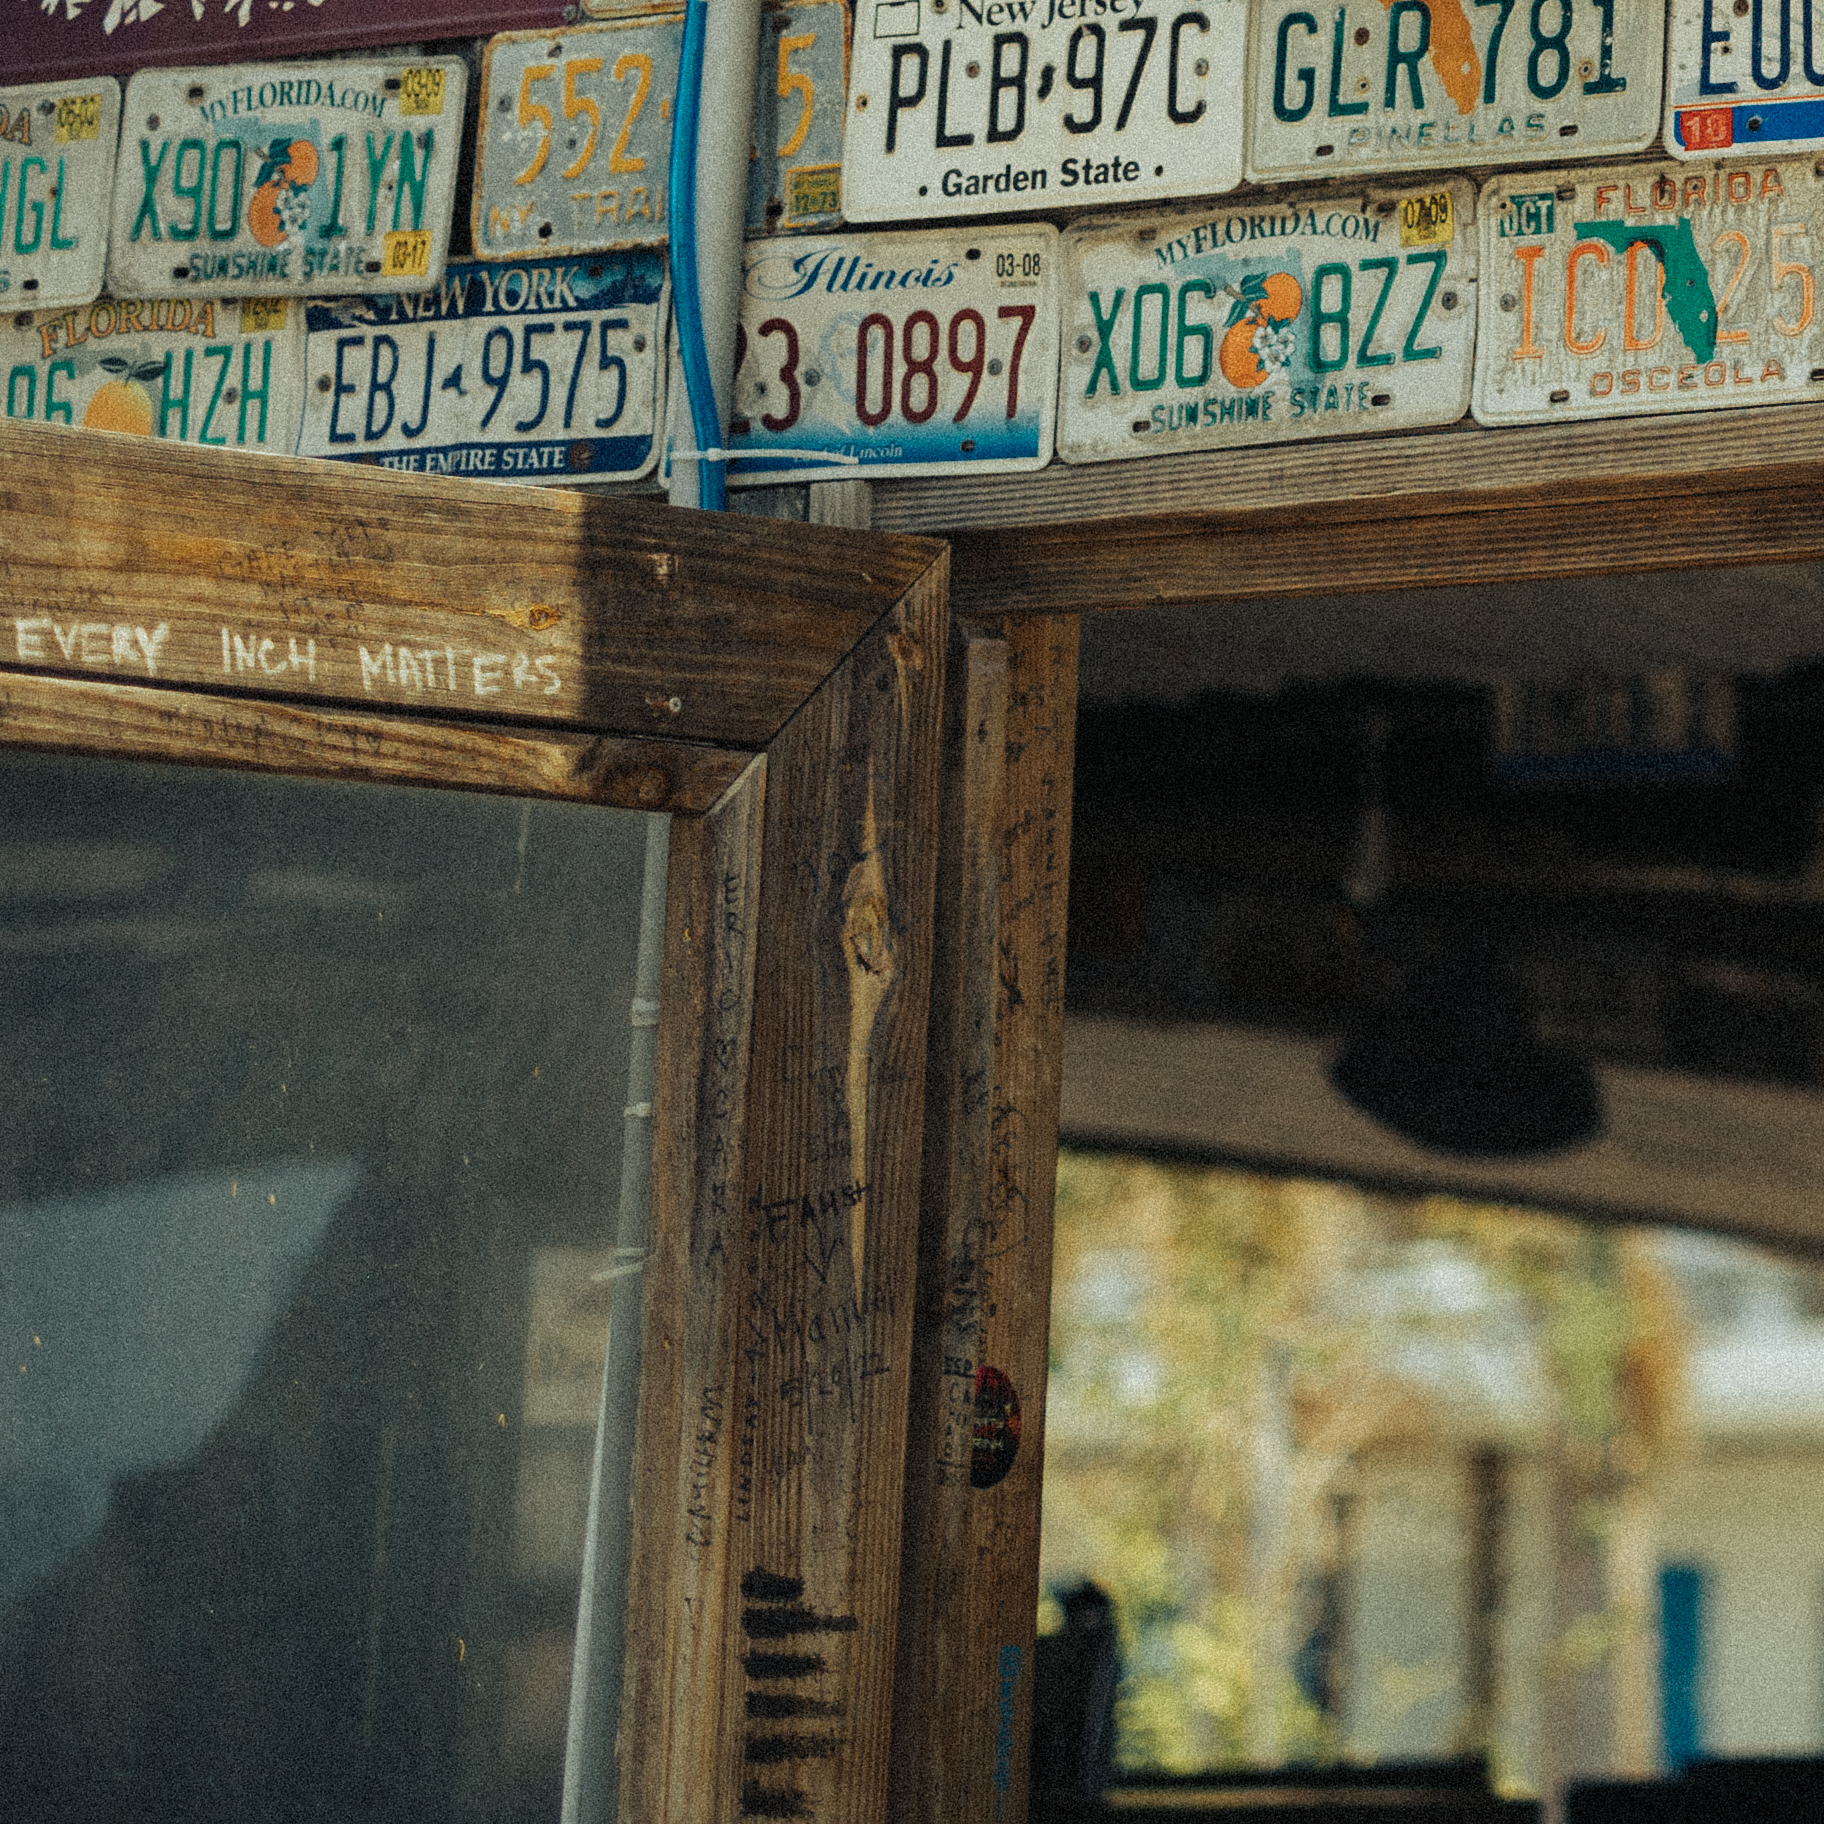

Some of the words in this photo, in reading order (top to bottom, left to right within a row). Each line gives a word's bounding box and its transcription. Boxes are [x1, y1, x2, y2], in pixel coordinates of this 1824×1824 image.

[1062, 10, 1211, 140] 97C
[199, 79, 387, 127] MYFLORIDA.COM
[513, 54, 652, 187] 552
[132, 134, 244, 242] X90
[940, 163, 1049, 200] Garden
[1058, 156, 1141, 189] State
[188, 245, 290, 284] SUNSHINE
[302, 244, 367, 277] STATE
[479, 267, 580, 310] YORK
[995, 252, 1042, 277] 03-08
[328, 332, 435, 446] EBJ
[479, 316, 630, 432] 9575
[854, 303, 1037, 427] 0897
[1588, 364, 1788, 400] OSCEOLA
[1150, 390, 1274, 434] SUNSHINE
[1290, 380, 1371, 419] STATE
[382, 454, 436, 475] THE
[441, 451, 495, 473] EMPIRE
[501, 445, 567, 471] STATE
[13, 617, 169, 677] EVERY
[220, 627, 318, 683] INCH
[358, 642, 563, 697] MATTERS
